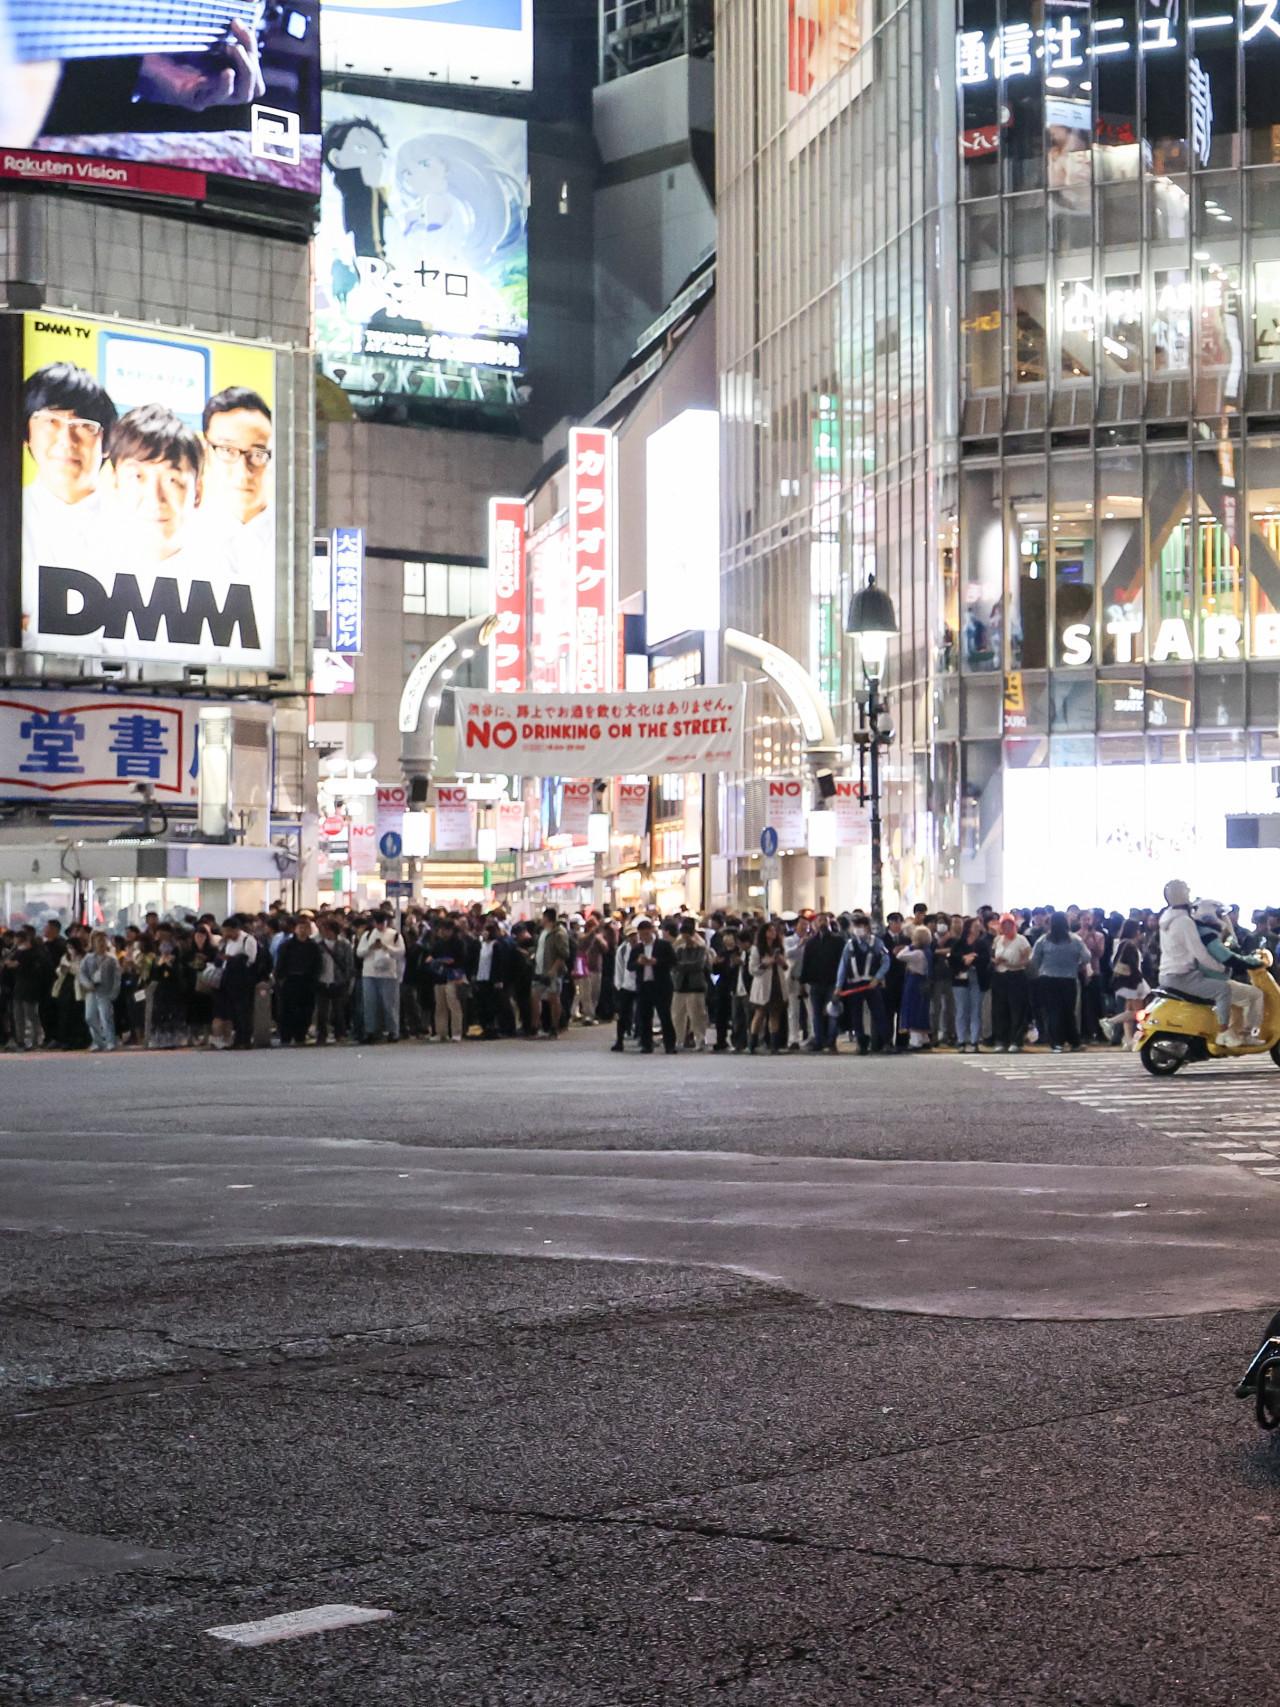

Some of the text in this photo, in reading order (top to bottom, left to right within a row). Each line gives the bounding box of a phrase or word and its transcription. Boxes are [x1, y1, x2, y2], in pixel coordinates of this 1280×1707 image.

[4, 155, 128, 181] Rakuten Vision
[34, 321, 91, 339] DMM TV
[576, 449, 605, 592] カラオケ
[38, 565, 261, 649] DMM
[466, 719, 518, 749] NO
[522, 724, 601, 740] DRINKING
[608, 724, 632, 738] ON
[638, 721, 668, 738] THE
[673, 717, 732, 737] STREET.
[19, 711, 199, 779] 堂書
[377, 788, 406, 801] NO
[438, 788, 467, 801] NO
[563, 784, 591, 796] NO
[620, 785, 646, 797] NO
[769, 782, 801, 797] NO
[837, 783, 867, 797] NO
[500, 805, 522, 814] NO
[353, 826, 376, 837] NO
